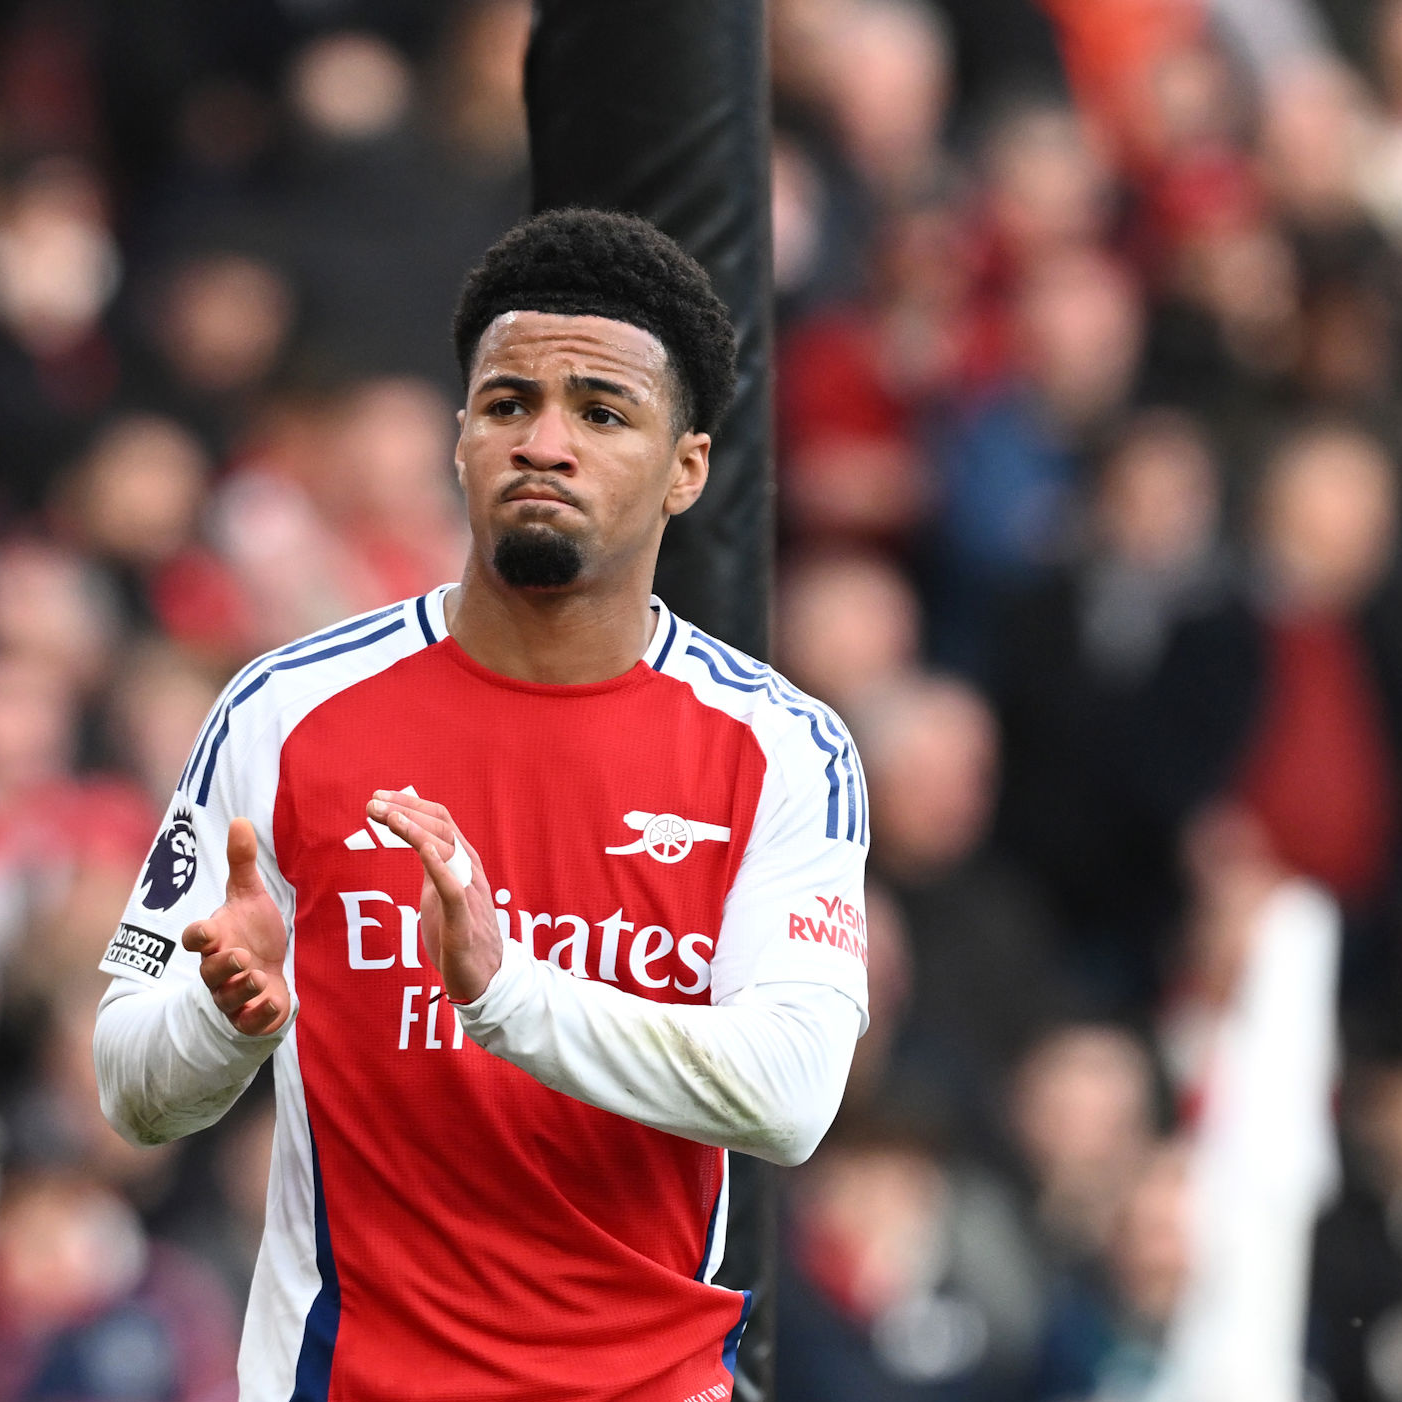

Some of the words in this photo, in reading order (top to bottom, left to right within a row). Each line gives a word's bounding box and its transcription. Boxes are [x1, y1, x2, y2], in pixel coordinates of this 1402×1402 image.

[124, 930, 166, 958] room
[789, 912, 868, 968] RWAN
[118, 947, 165, 979] racism
